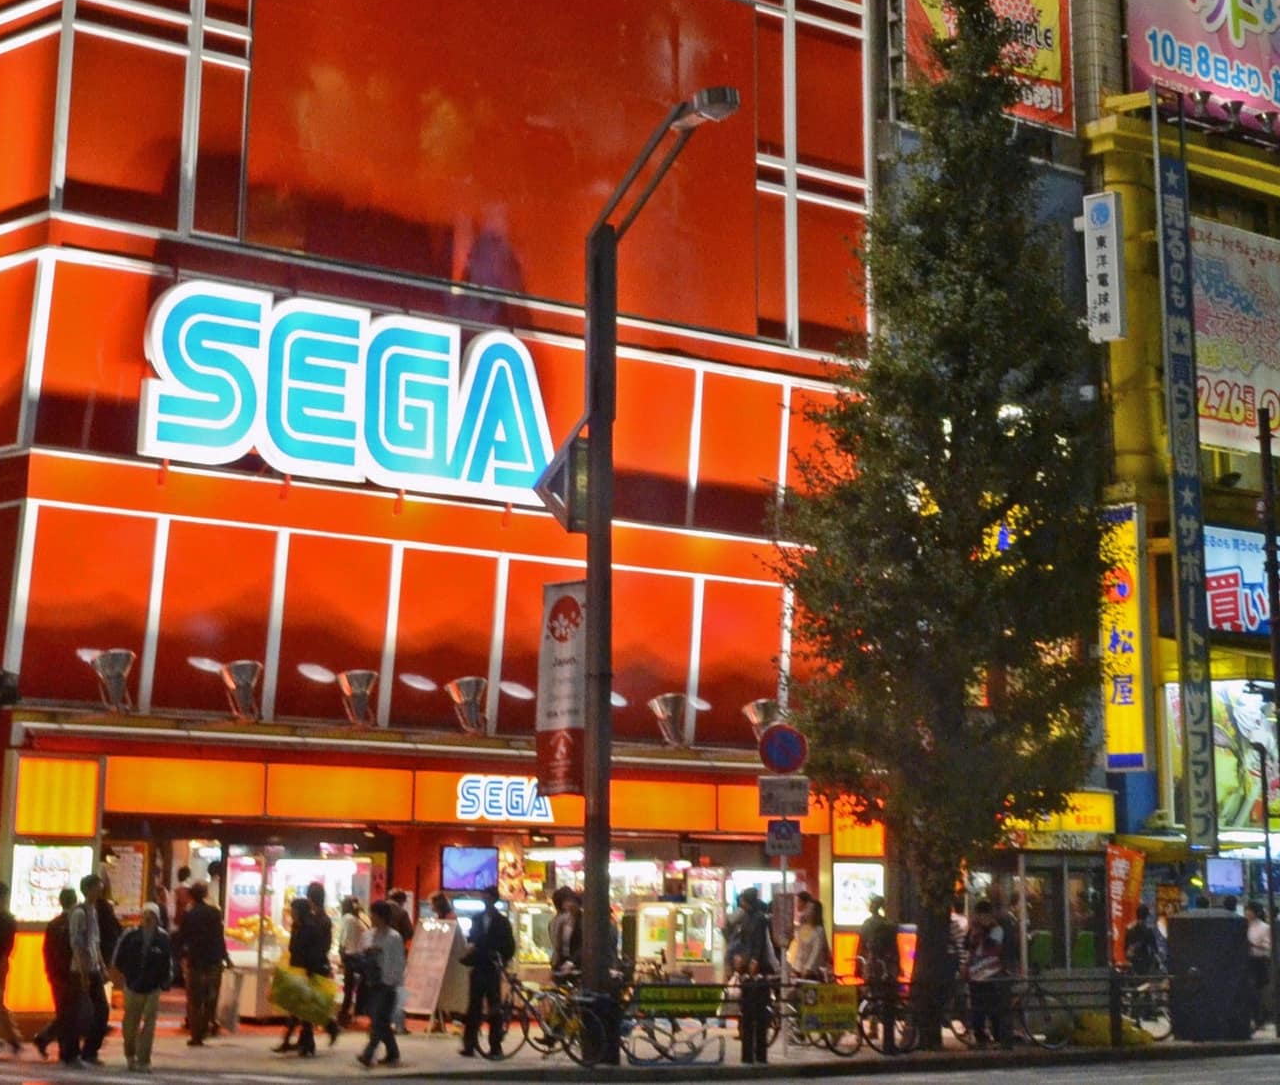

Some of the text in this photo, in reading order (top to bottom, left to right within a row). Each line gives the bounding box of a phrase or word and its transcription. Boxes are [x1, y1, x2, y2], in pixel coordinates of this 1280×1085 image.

[137, 280, 556, 507] SEGA
[1108, 625, 1136, 706] 松屋
[457, 773, 555, 823] SEGA
